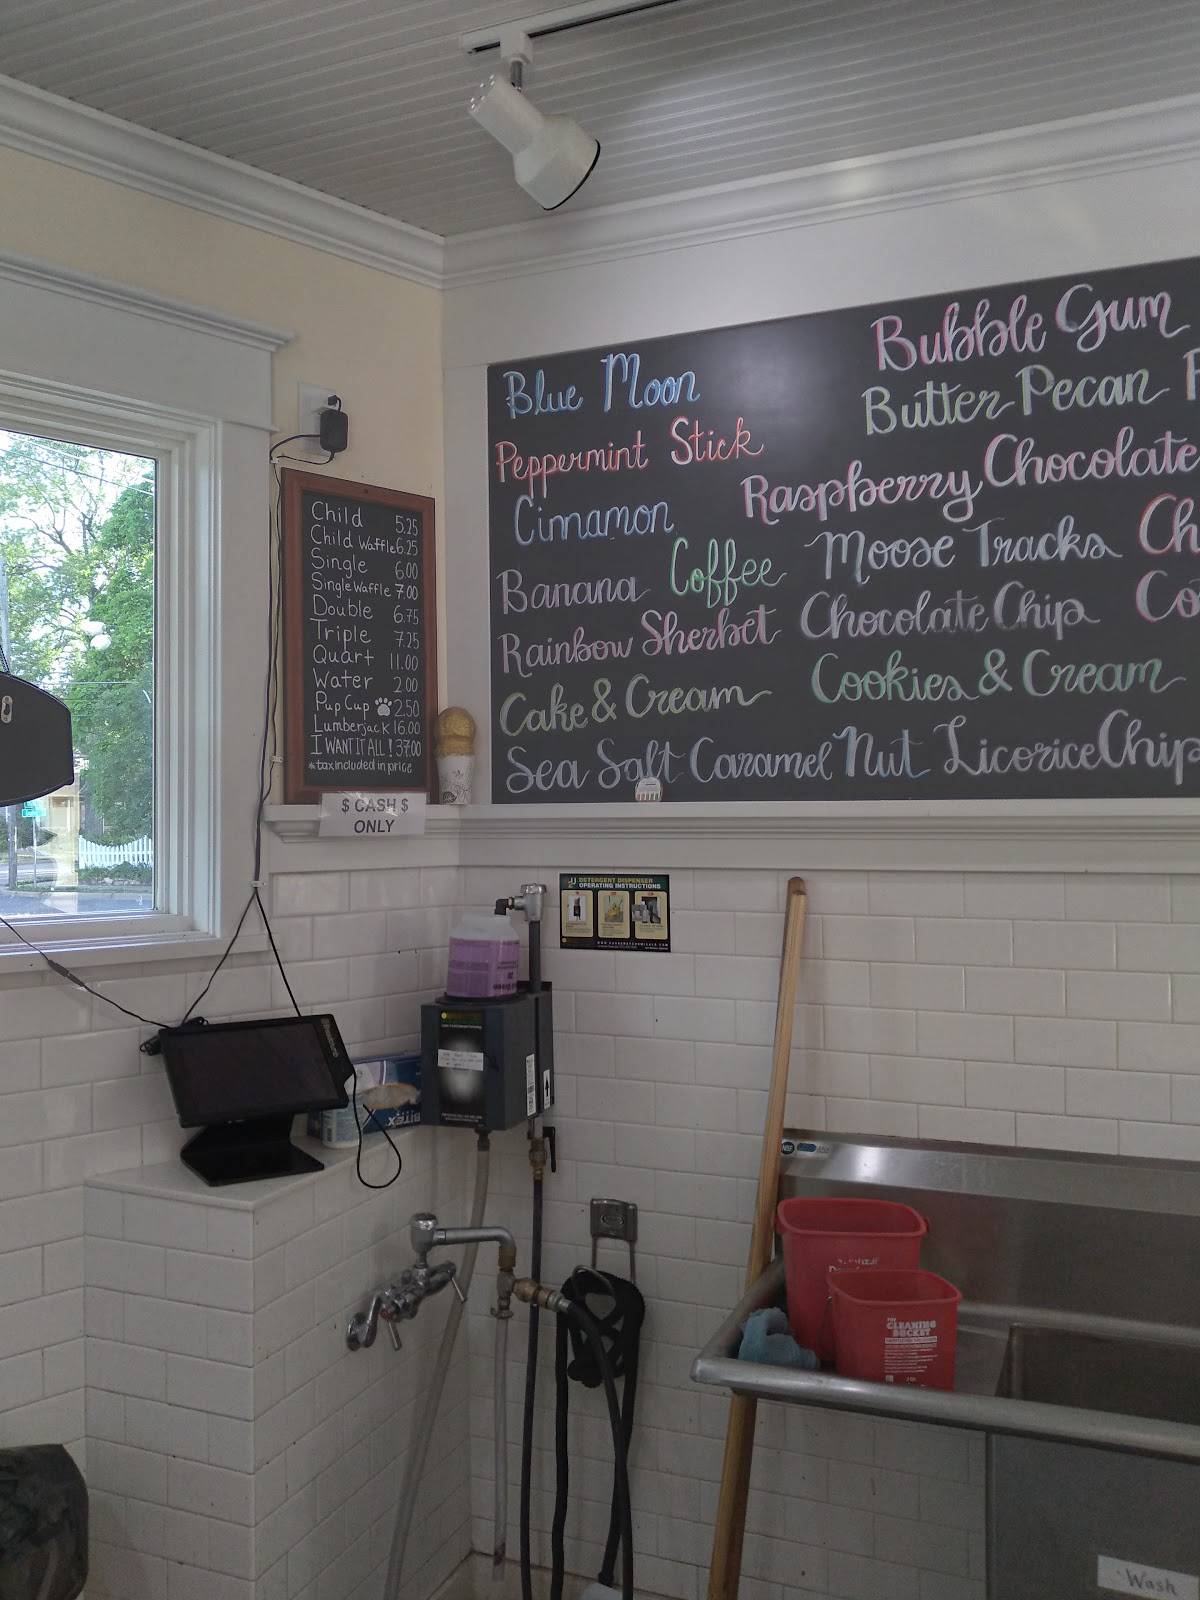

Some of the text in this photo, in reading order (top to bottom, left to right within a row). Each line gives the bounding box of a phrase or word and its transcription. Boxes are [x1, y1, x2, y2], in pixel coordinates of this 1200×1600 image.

[870, 283, 1191, 371] Bubble Gum
[502, 352, 701, 419] Blue Moon
[861, 380, 1015, 436] Butter
[1015, 364, 1171, 416] Pecan
[494, 416, 764, 499] Peppermint Stick
[740, 426, 1200, 525] Raspberry Chocolate
[311, 501, 419, 536] Child 5.25
[514, 495, 675, 546] Cinnamon
[310, 524, 419, 556] Child Waffle 6.25
[804, 515, 1122, 585] Moose Tracks
[311, 547, 419, 580] Single 6.00
[670, 537, 787, 608] Coffee
[311, 571, 419, 600] Single Waffle 7.00
[495, 569, 651, 615] Banana
[313, 594, 419, 625] Double 6.75
[800, 581, 1100, 641] Chocolate Chip
[309, 617, 420, 651] Triple 7.25
[497, 603, 782, 678] Rainbow Sherbet
[313, 644, 419, 671] Quart 11.00
[312, 667, 374, 690] Water
[811, 648, 1186, 704] Cookies & Cream
[315, 690, 341, 717] Pup
[345, 694, 370, 720] Cup
[500, 673, 773, 737] Cake & Cream
[313, 713, 421, 736] Lumberjack 16.00
[310, 734, 323, 755] I
[324, 736, 353, 755] WANT
[355, 737, 366, 755] IT
[395, 738, 422, 758] 37.00
[506, 725, 931, 794] Sea Salt Caramel Nut
[933, 715, 1101, 776] Licorice
[335, 758, 376, 771] included
[377, 760, 386, 770] in
[387, 761, 413, 775] price
[341, 798, 409, 813] $ CASH $
[354, 820, 395, 834] ONLY
[886, 1320, 937, 1330] CLEANING
[892, 1328, 931, 1337] BUCKET
